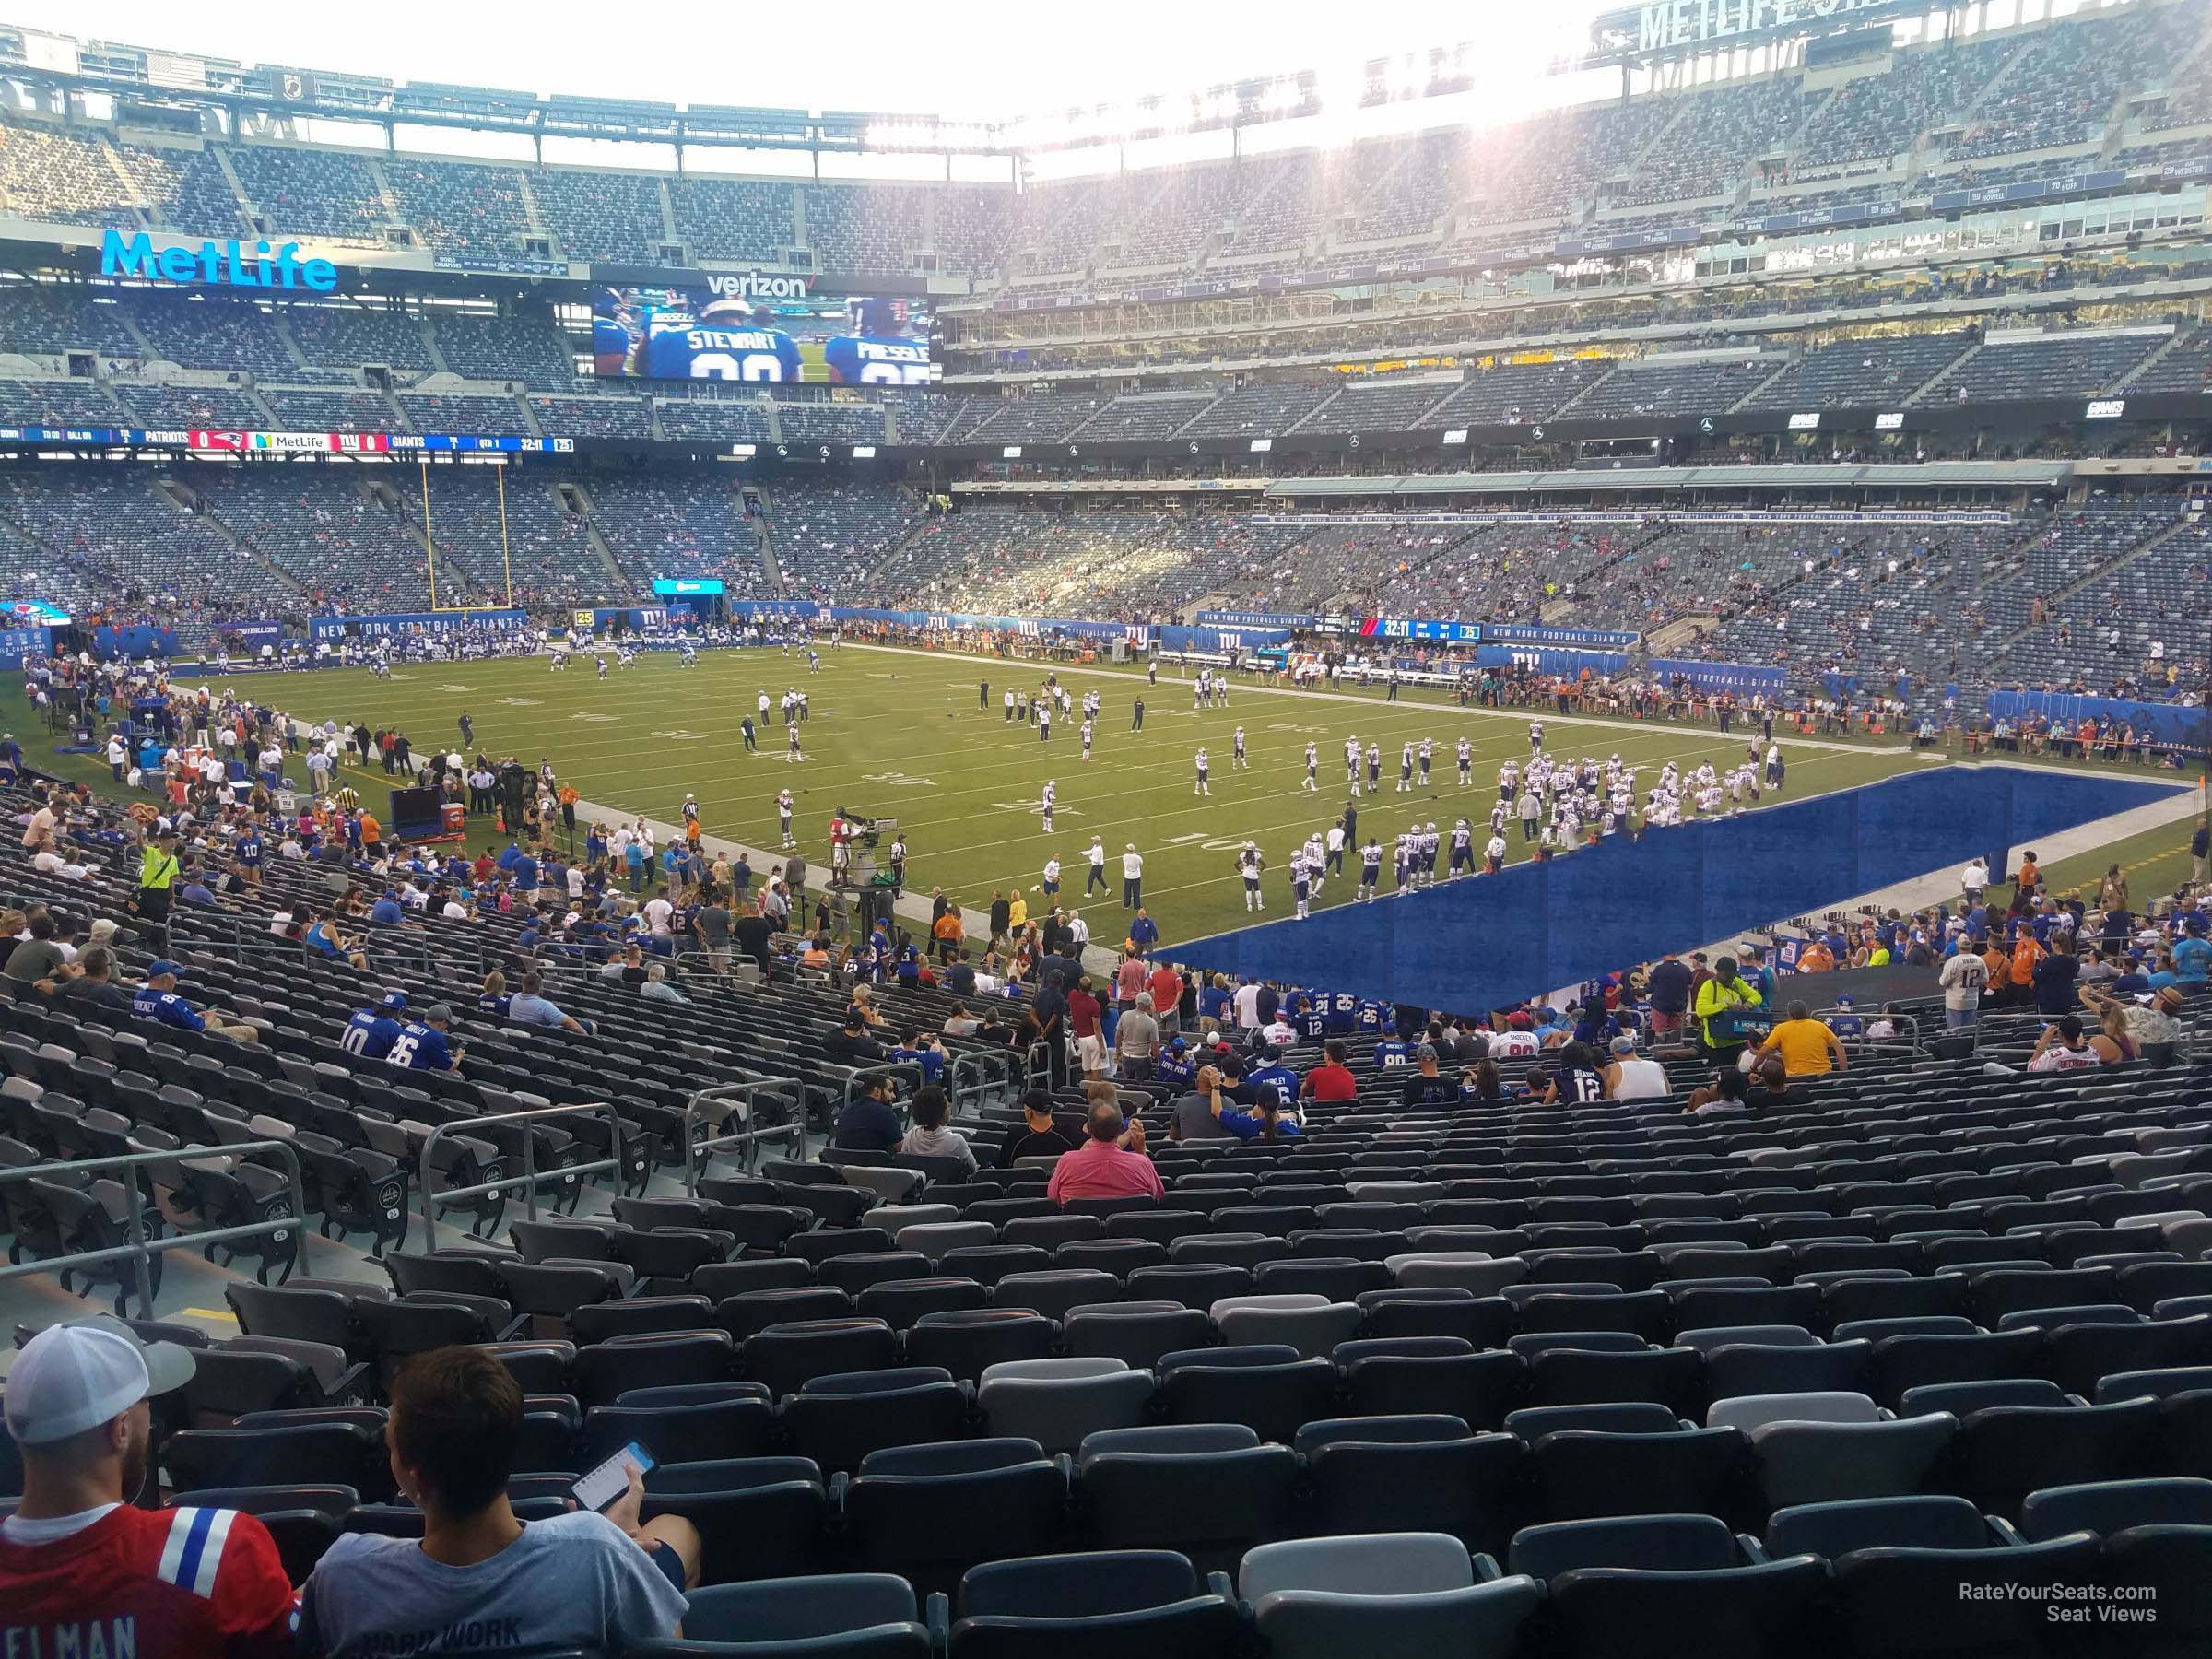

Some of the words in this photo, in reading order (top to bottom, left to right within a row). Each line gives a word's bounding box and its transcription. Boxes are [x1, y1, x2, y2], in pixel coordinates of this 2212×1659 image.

[2062, 182, 2077, 191] HUFF
[101, 229, 337, 290] MetLife
[707, 272, 806, 298] verizon
[687, 330, 777, 349] STEWART
[2086, 401, 2124, 414] GIANTS
[145, 431, 189, 443] PATRIOTS
[276, 436, 323, 448] MetLife
[392, 437, 426, 448] GIANTS
[577, 612, 593, 624] 25
[1242, 616, 1277, 624] FOOTBALL
[319, 624, 347, 637] NEW
[1384, 619, 1409, 636] 32:11
[1493, 629, 1511, 637] NEW
[1543, 631, 1587, 641] FOOTBALL
[1593, 634, 1626, 643] GIANTS
[1698, 673, 1745, 686] FOOTBALL
[244, 845, 258, 858] 10
[673, 915, 687, 931] 12
[1962, 969, 1980, 988] 12
[1315, 999, 1328, 1016] 21
[1363, 1009, 1377, 1024] 26
[1308, 1020, 1323, 1036] 12
[339, 1025, 369, 1056] 10
[385, 1034, 418, 1068] 26
[1174, 1065, 1188, 1076] PINK
[1574, 1077, 1601, 1102] 12
[388, 1209, 398, 1218] 24
[276, 1230, 286, 1241] 25
[440, 1616, 523, 1648] WORK
